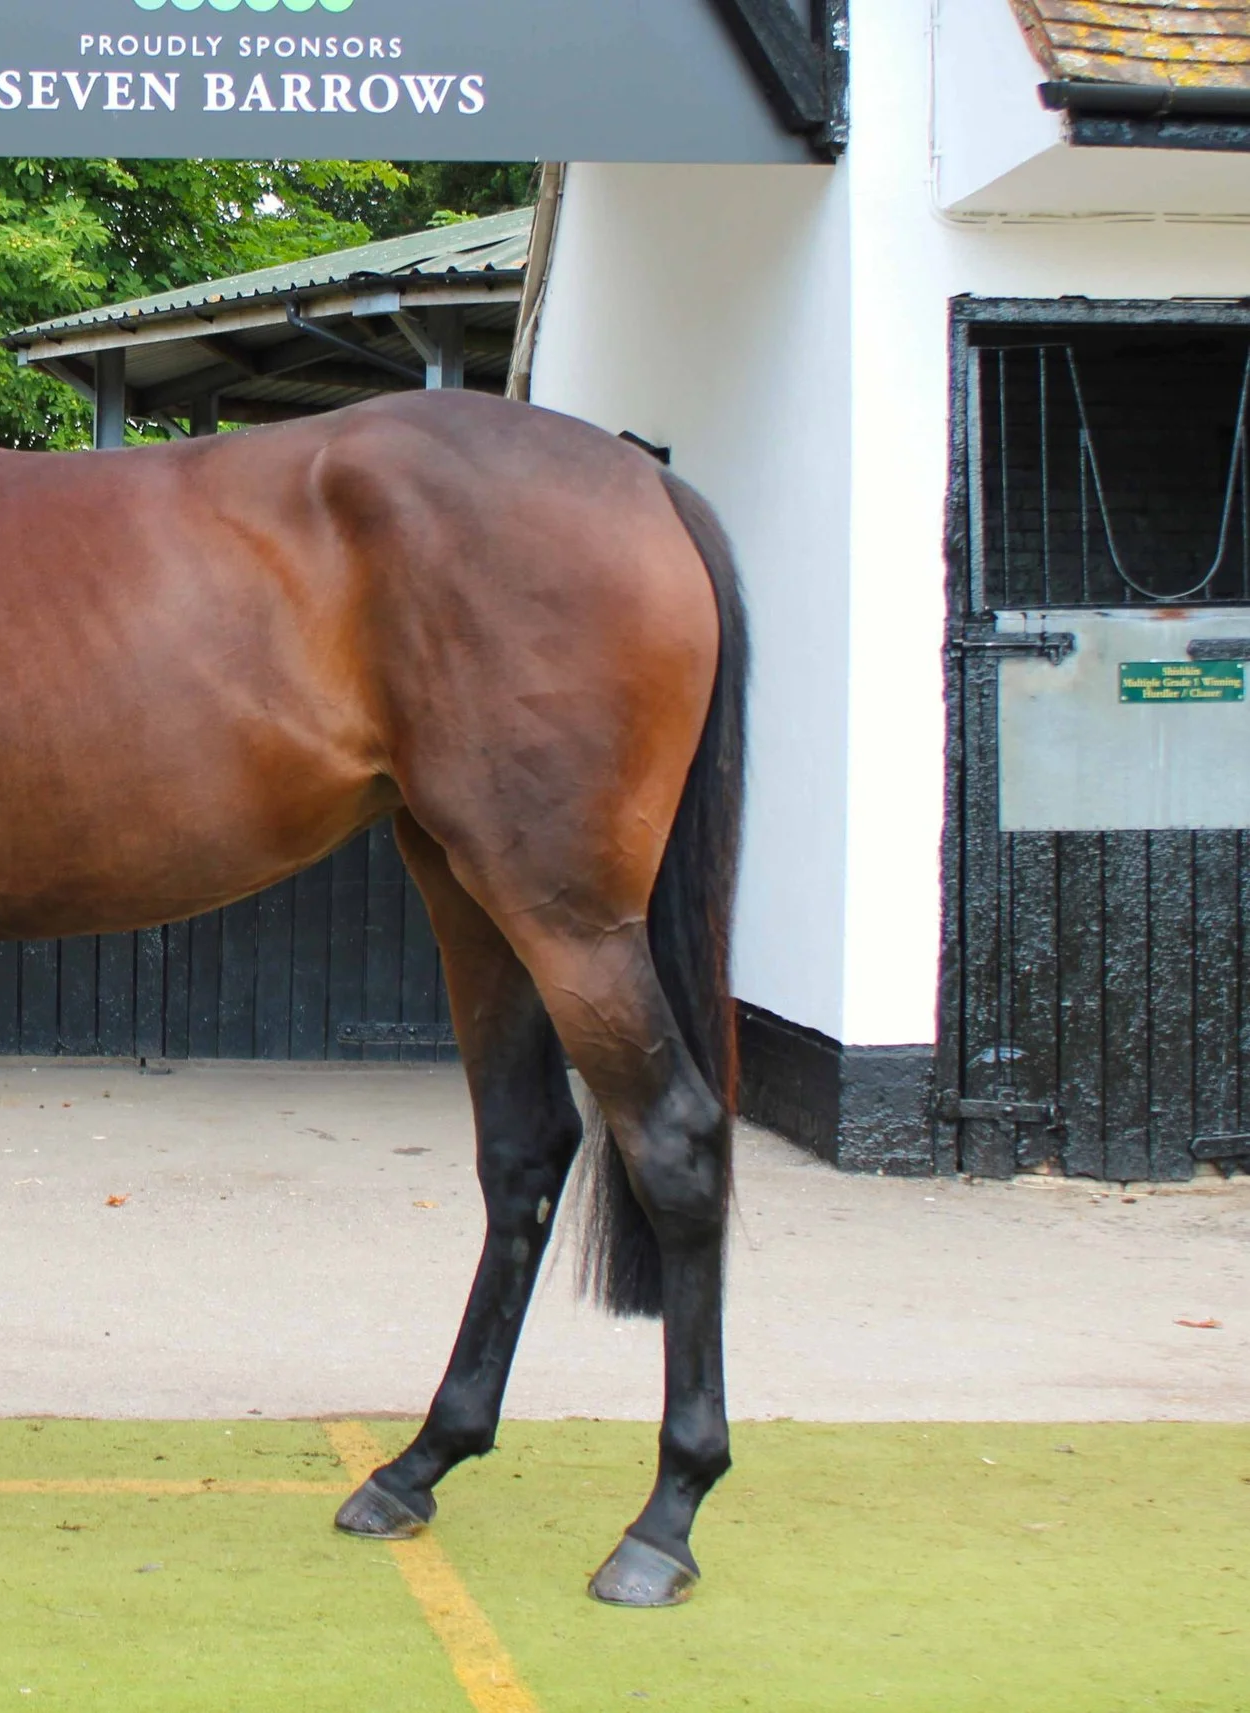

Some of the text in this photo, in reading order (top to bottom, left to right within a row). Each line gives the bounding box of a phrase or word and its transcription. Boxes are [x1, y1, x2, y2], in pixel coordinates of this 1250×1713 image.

[79, 34, 404, 60] PROUDLY SPONSORS
[202, 72, 487, 115] BARROWS
